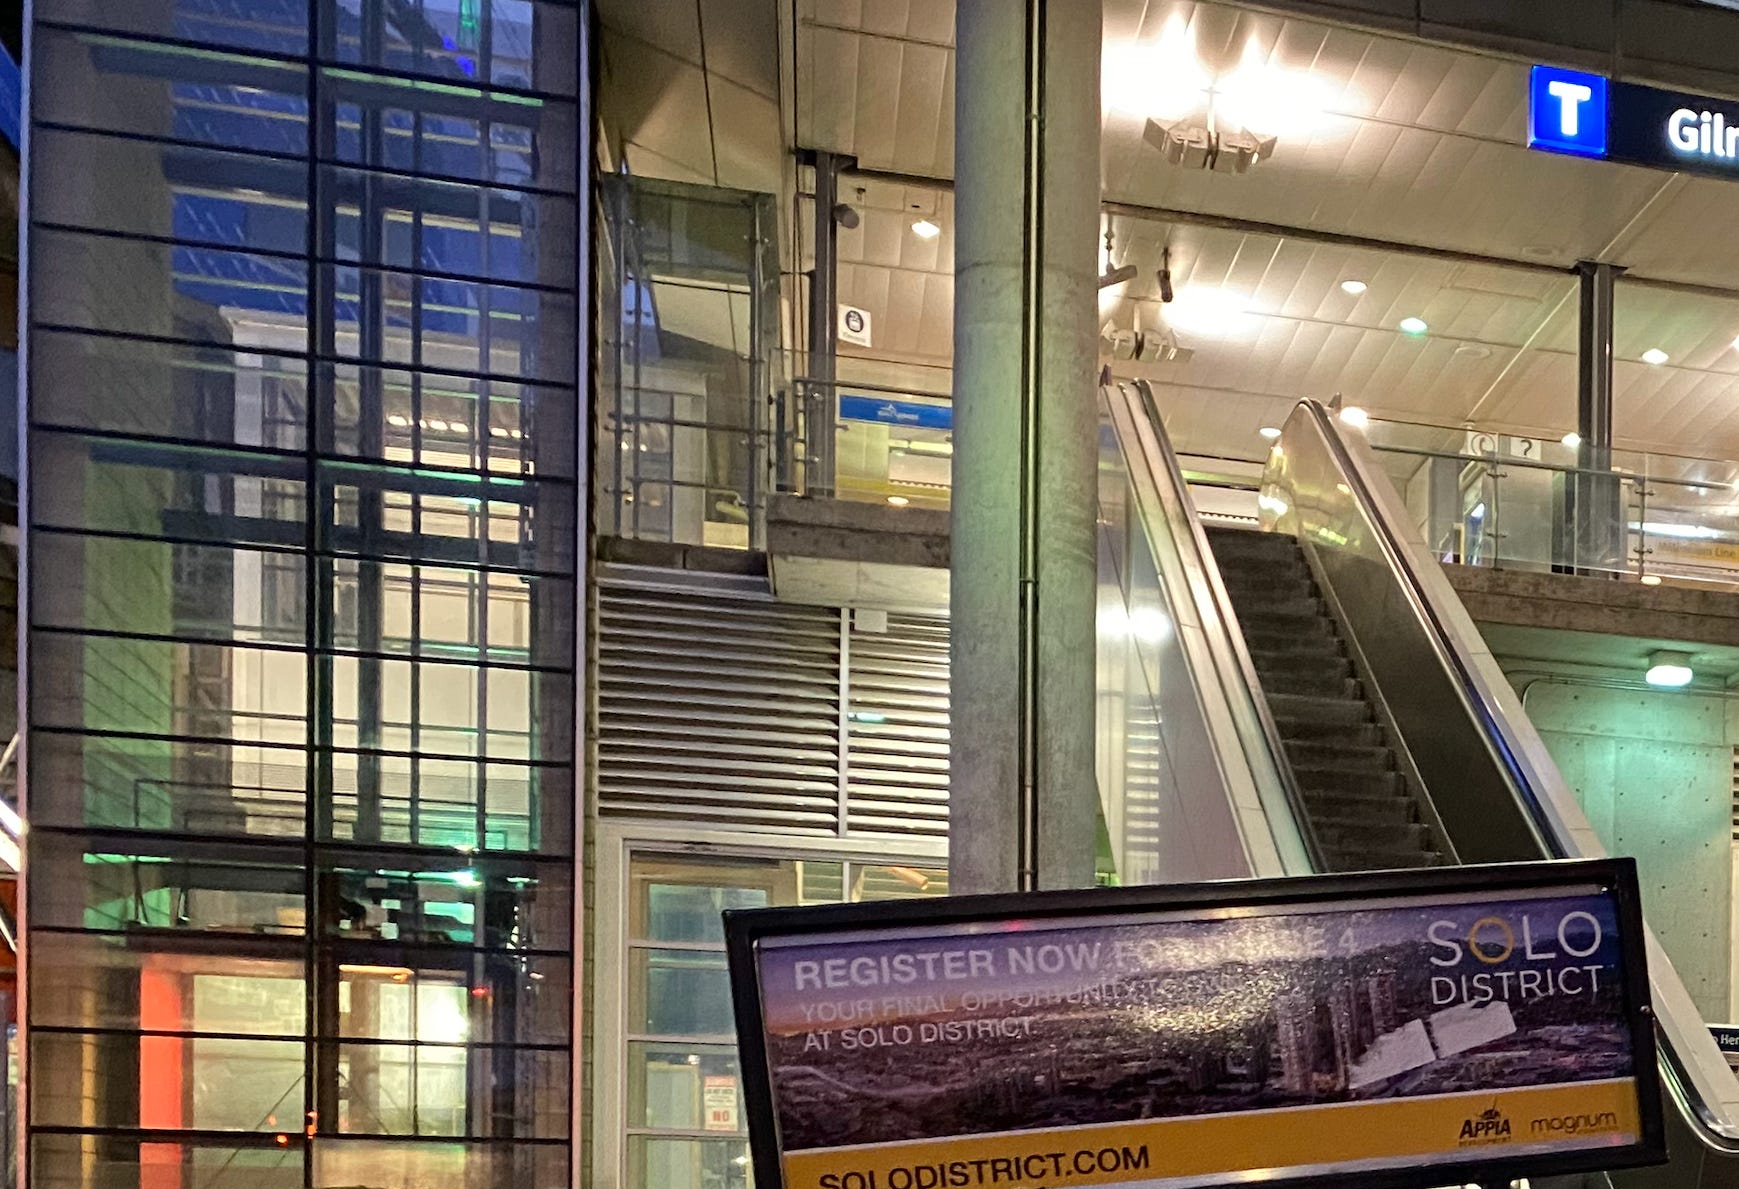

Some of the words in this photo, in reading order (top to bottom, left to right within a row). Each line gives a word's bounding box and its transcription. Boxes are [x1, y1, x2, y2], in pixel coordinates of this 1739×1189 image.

[1549, 81, 1592, 136] T
[1427, 911, 1601, 967] SOLO
[794, 949, 995, 991] REGISTER
[1007, 942, 1101, 975] NOW
[1430, 965, 1603, 1005] DISTRICT
[801, 997, 874, 1023] YOUR
[881, 992, 949, 1017] FINAL
[803, 1031, 832, 1052] AT
[841, 1023, 913, 1051] SOLO
[919, 1015, 1032, 1044] DISTRICT
[1459, 1118, 1512, 1140] APPIA
[1530, 1111, 1618, 1134] magnum
